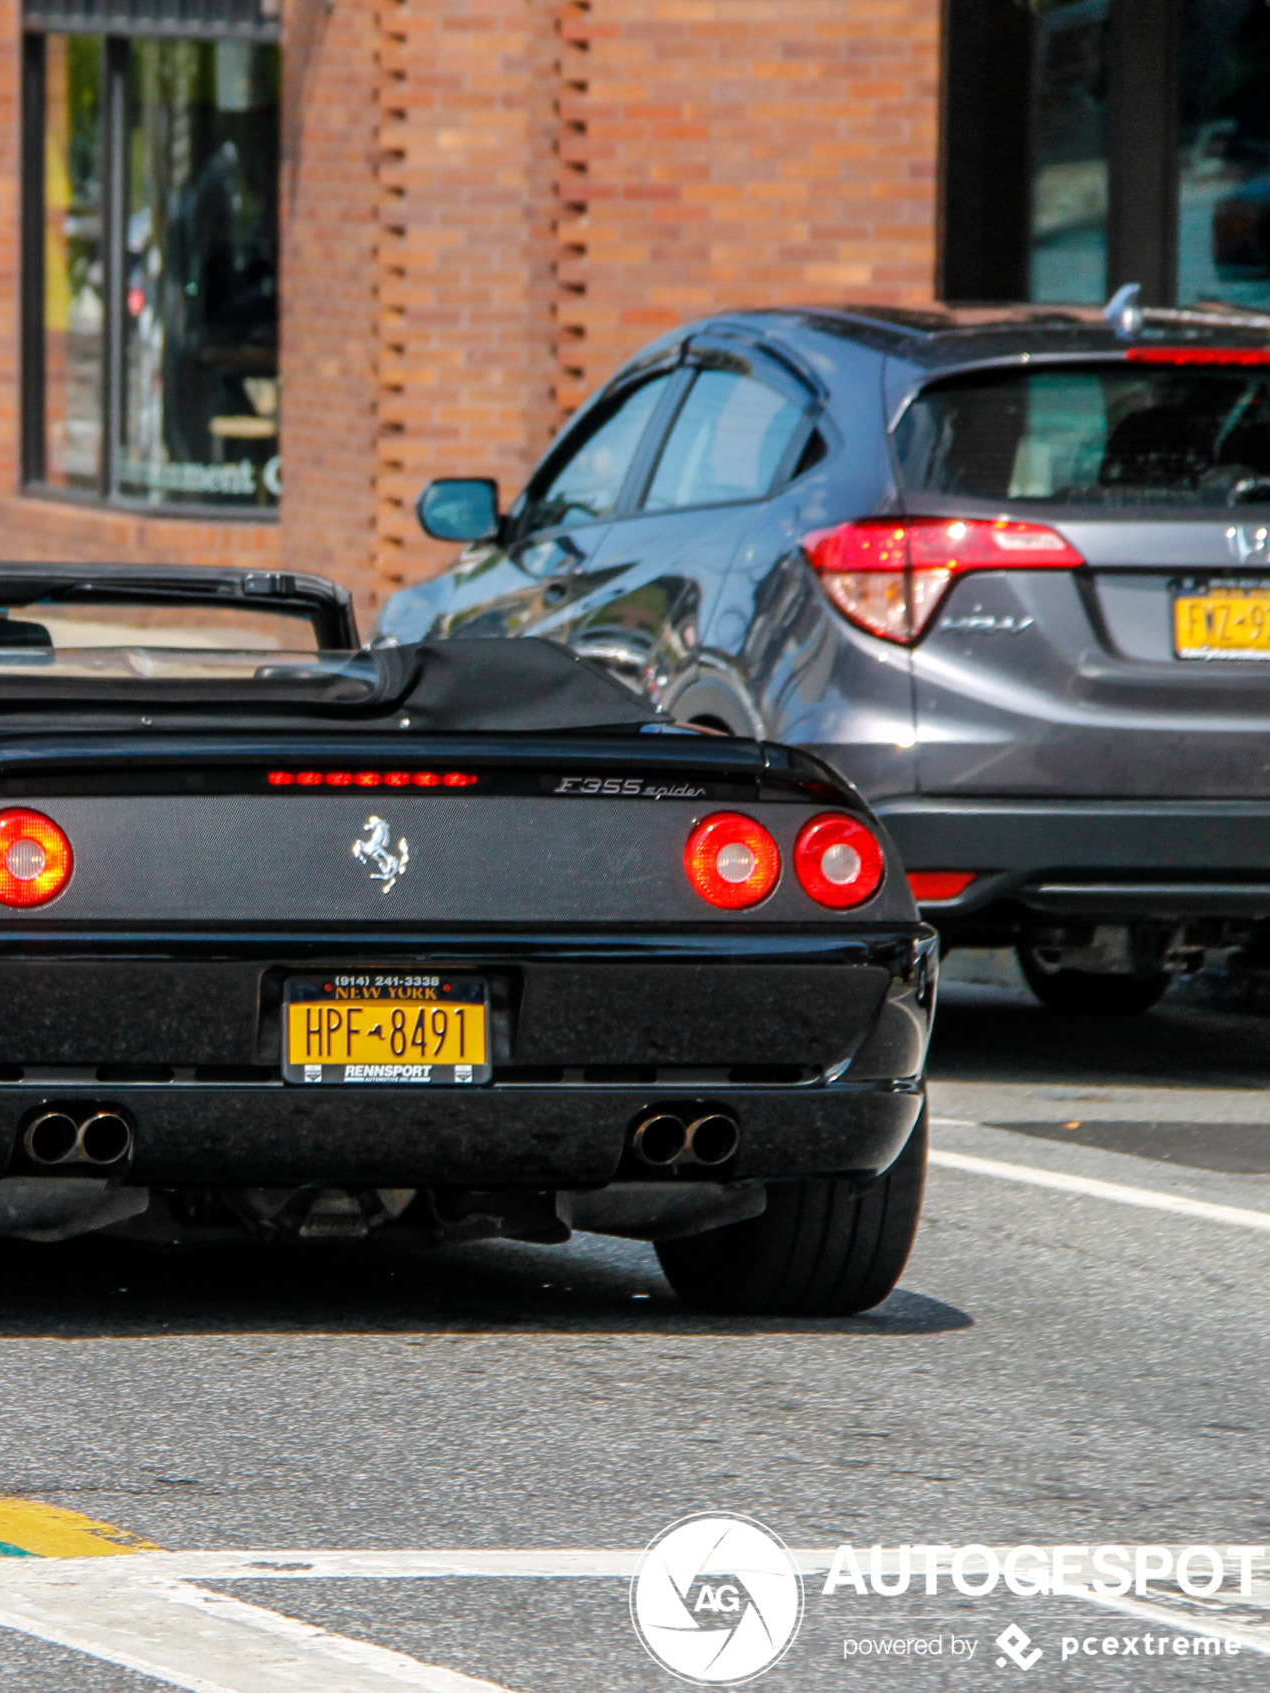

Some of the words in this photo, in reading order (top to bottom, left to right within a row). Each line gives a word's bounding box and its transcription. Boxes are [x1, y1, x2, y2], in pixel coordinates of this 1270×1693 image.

[554, 777, 643, 794] F355
[642, 784, 706, 801] spider
[335, 976, 370, 987] (914)
[375, 976, 440, 987] 241-3338
[335, 987, 381, 999] NEW
[388, 987, 438, 1000] YORK
[345, 1065, 432, 1077] RENNSPORT
